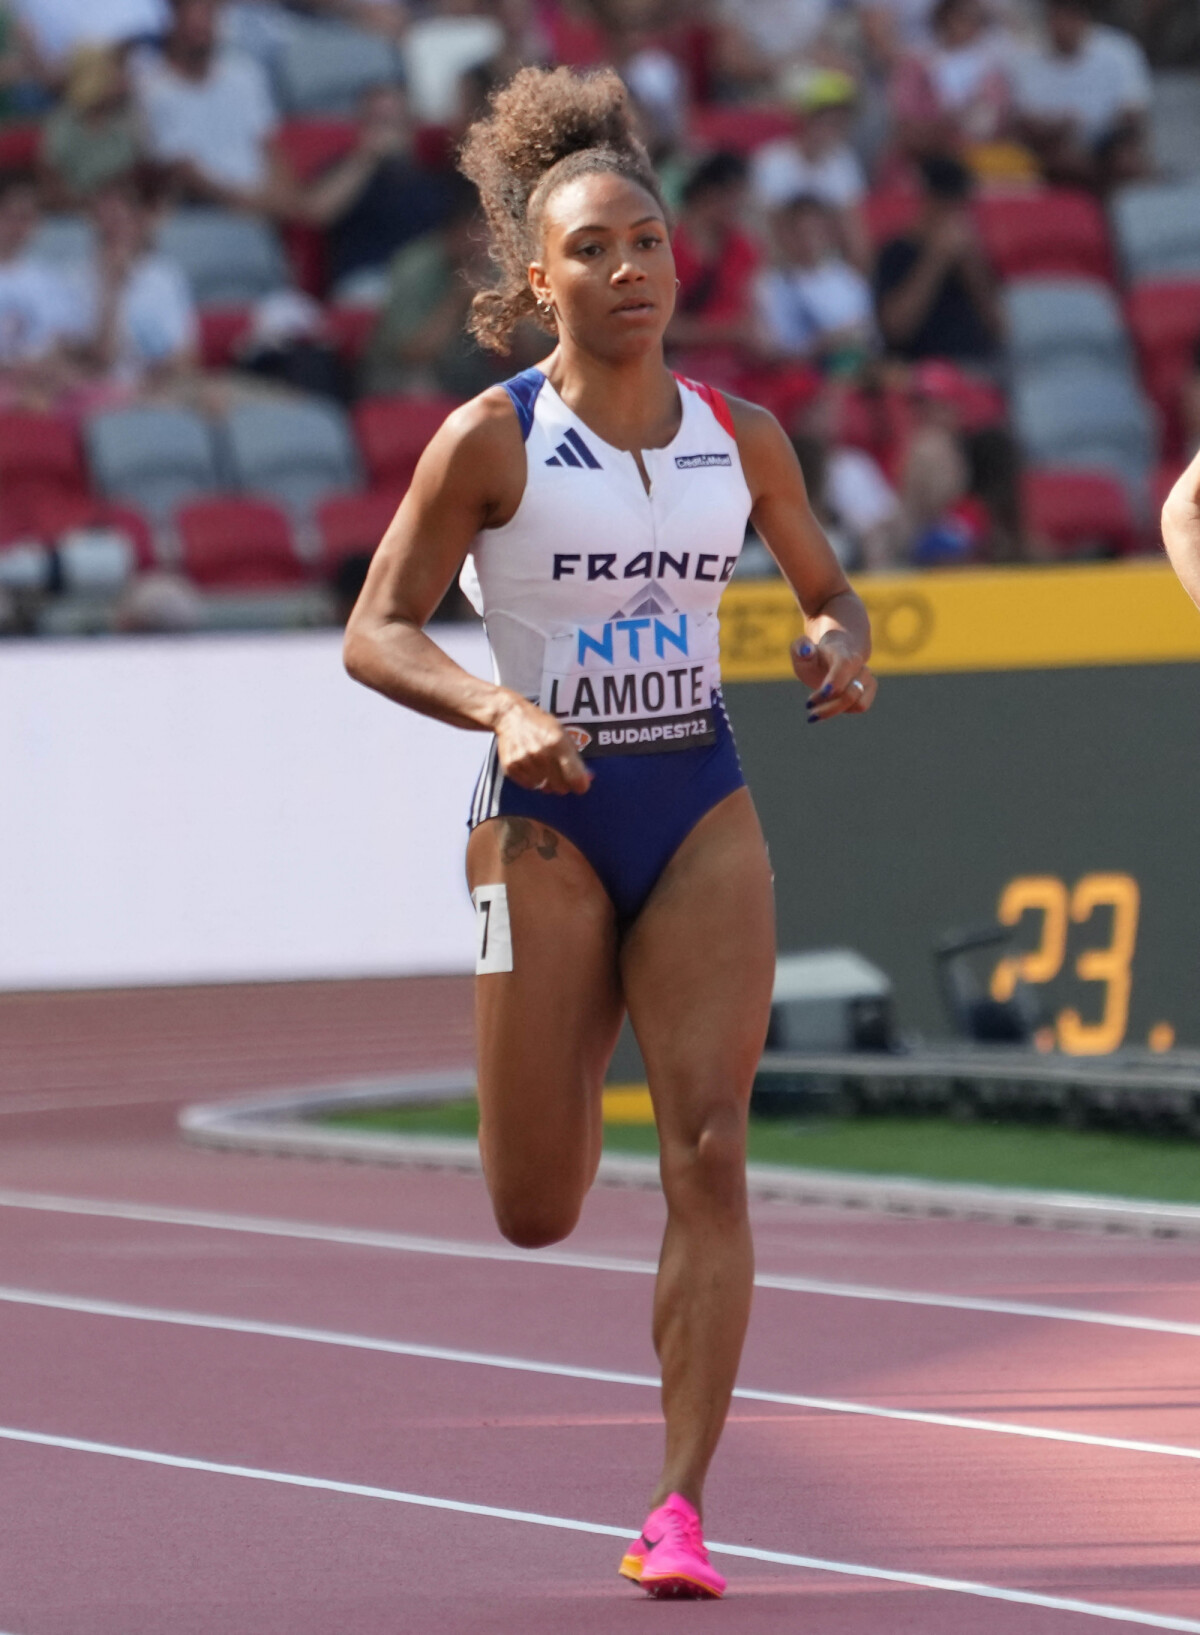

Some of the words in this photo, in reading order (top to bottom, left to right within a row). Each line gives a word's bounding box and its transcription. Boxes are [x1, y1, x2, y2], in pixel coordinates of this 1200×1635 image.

[577, 613, 689, 667] NTN
[550, 665, 704, 718] LAMOTE
[598, 719, 707, 746] BUDAPEST23
[479, 900, 492, 961] 7
